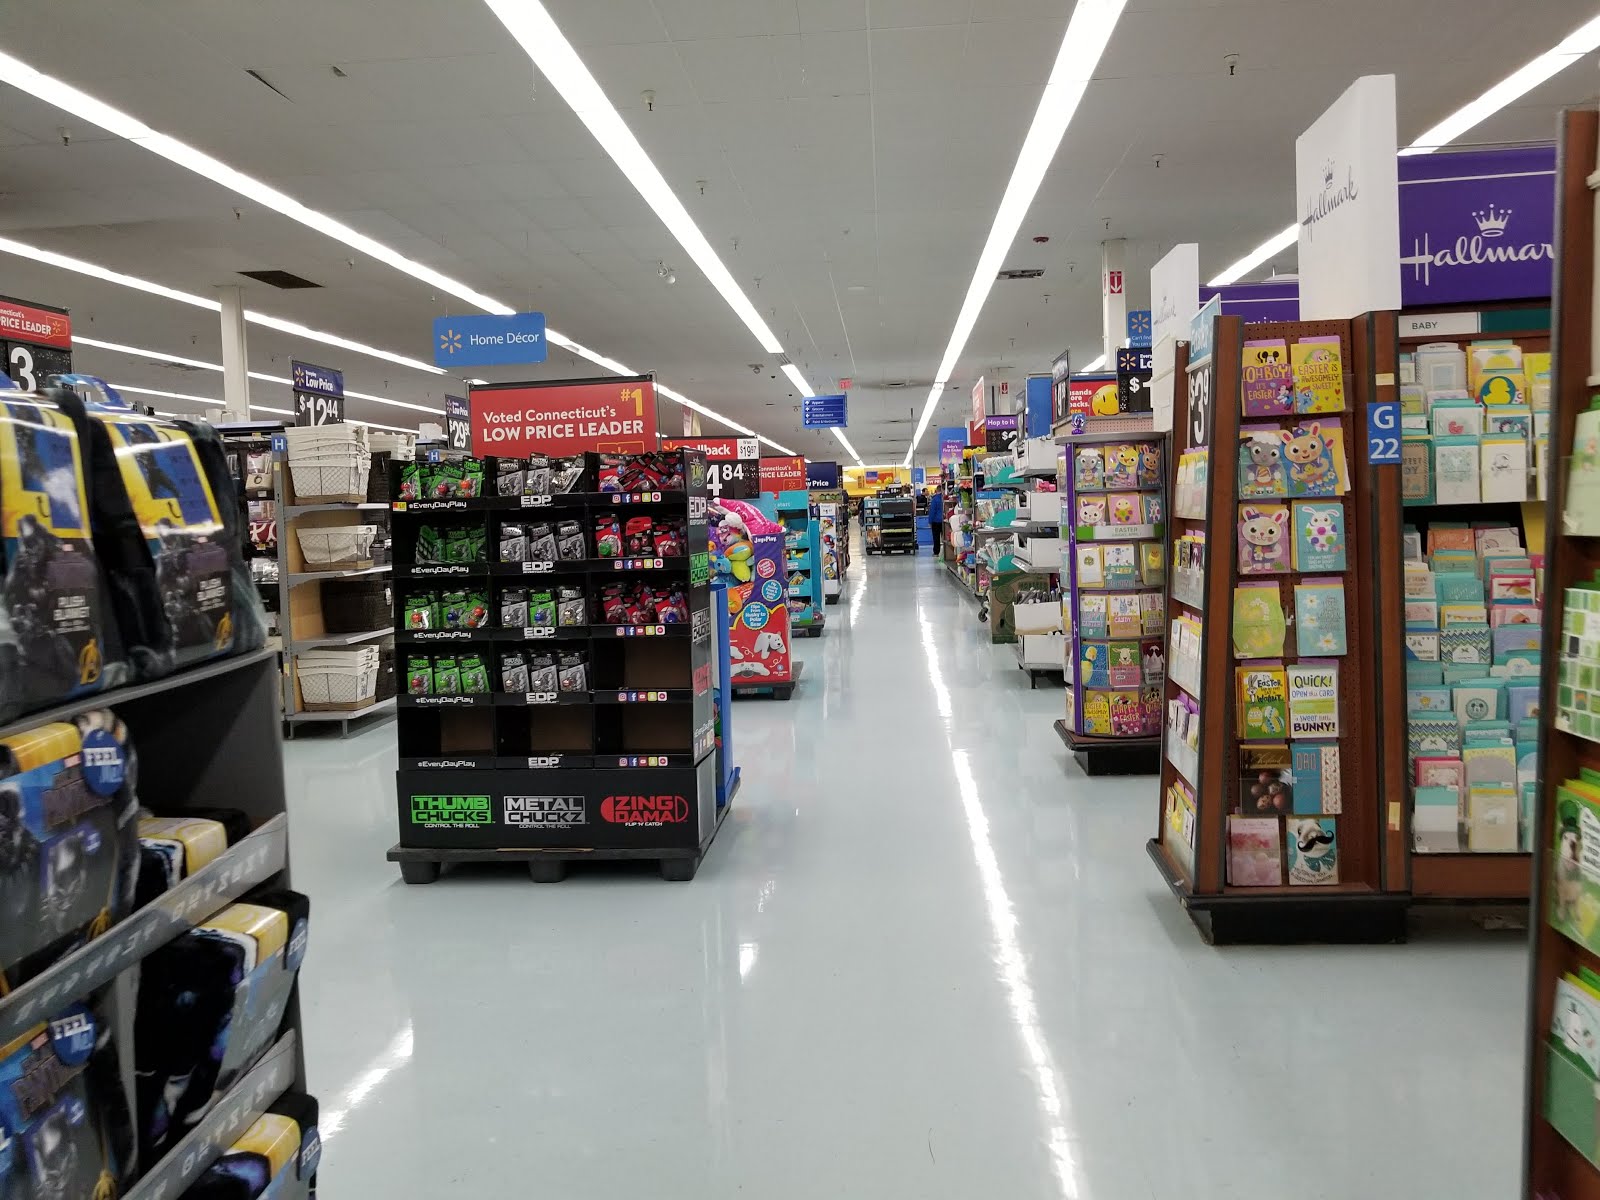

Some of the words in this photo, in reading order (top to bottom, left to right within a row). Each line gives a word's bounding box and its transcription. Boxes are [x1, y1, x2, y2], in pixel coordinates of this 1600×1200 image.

[1302, 165, 1359, 243] Hallmark
[1400, 232, 1556, 286] Hallmar
[21, 320, 52, 336] LEADER
[1411, 322, 1439, 330] BABY
[470, 333, 504, 345] Home
[506, 332, 540, 344] Décor
[10, 346, 37, 392] 3
[1140, 358, 1153, 369] Lo
[305, 375, 319, 389] Low
[319, 377, 334, 392] Price
[483, 411, 522, 424] Voted
[525, 405, 617, 422] Connecticut's
[1373, 404, 1395, 429] G
[987, 419, 1001, 427] Hop
[483, 426, 521, 442] LOW
[525, 423, 575, 440] PRICE
[579, 420, 644, 437] LEADER
[274, 438, 284, 450] H
[1370, 438, 1399, 459] 22
[431, 452, 438, 460] H
[759, 471, 776, 479] RICE
[409, 501, 467, 510] #EveryDayPlay
[520, 494, 552, 505] EDP
[689, 496, 708, 518] EDP
[411, 566, 469, 574] #EveryDayPlay
[522, 561, 554, 571] EDP
[524, 627, 556, 637] EDP
[526, 692, 558, 702] EDP
[1293, 722, 1336, 732] BUNNY!
[528, 757, 560, 767] EDP
[414, 797, 488, 810] THUMB
[507, 798, 582, 811] METAL
[615, 796, 674, 810] ZING
[415, 811, 488, 821] CHUCKS
[508, 812, 582, 822] CHUCKZ
[615, 811, 675, 823] DAMA
